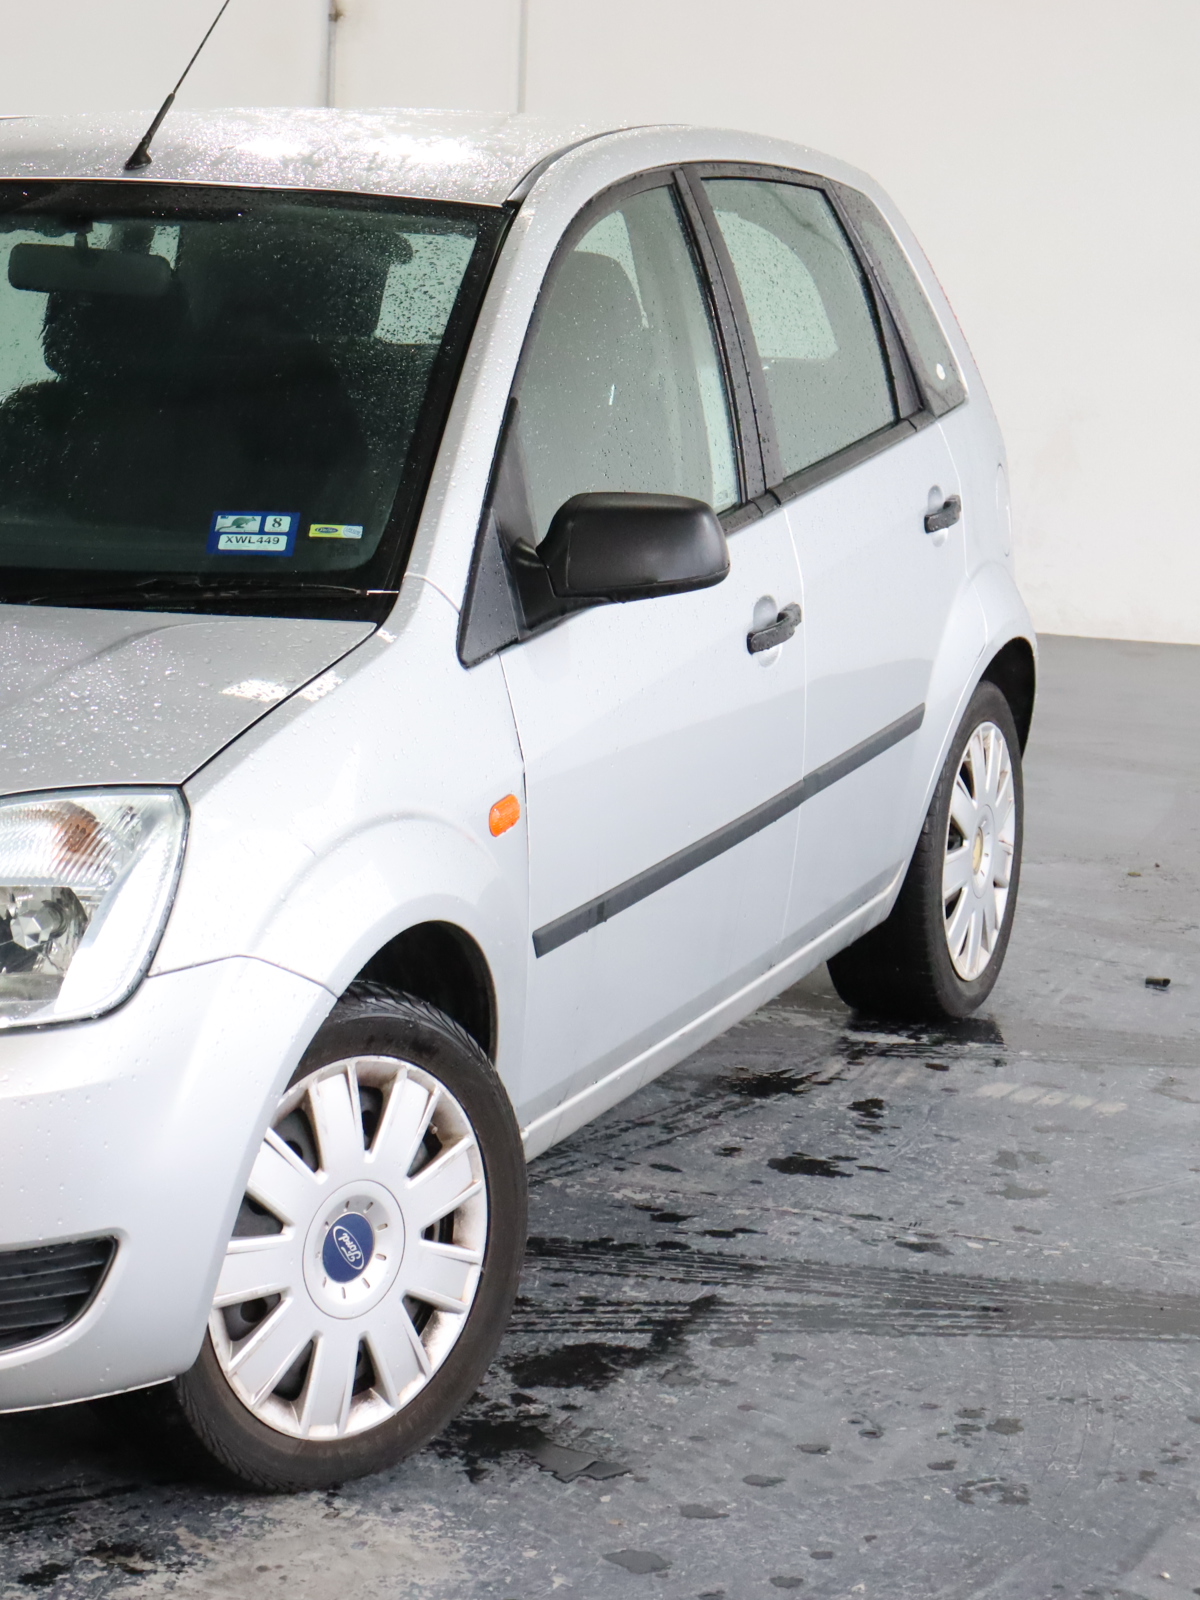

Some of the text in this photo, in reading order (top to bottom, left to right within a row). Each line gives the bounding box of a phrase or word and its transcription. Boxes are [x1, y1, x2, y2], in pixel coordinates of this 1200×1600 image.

[271, 517, 283, 528] 8
[225, 535, 280, 545] XWL449
[338, 1232, 363, 1263] Ford
